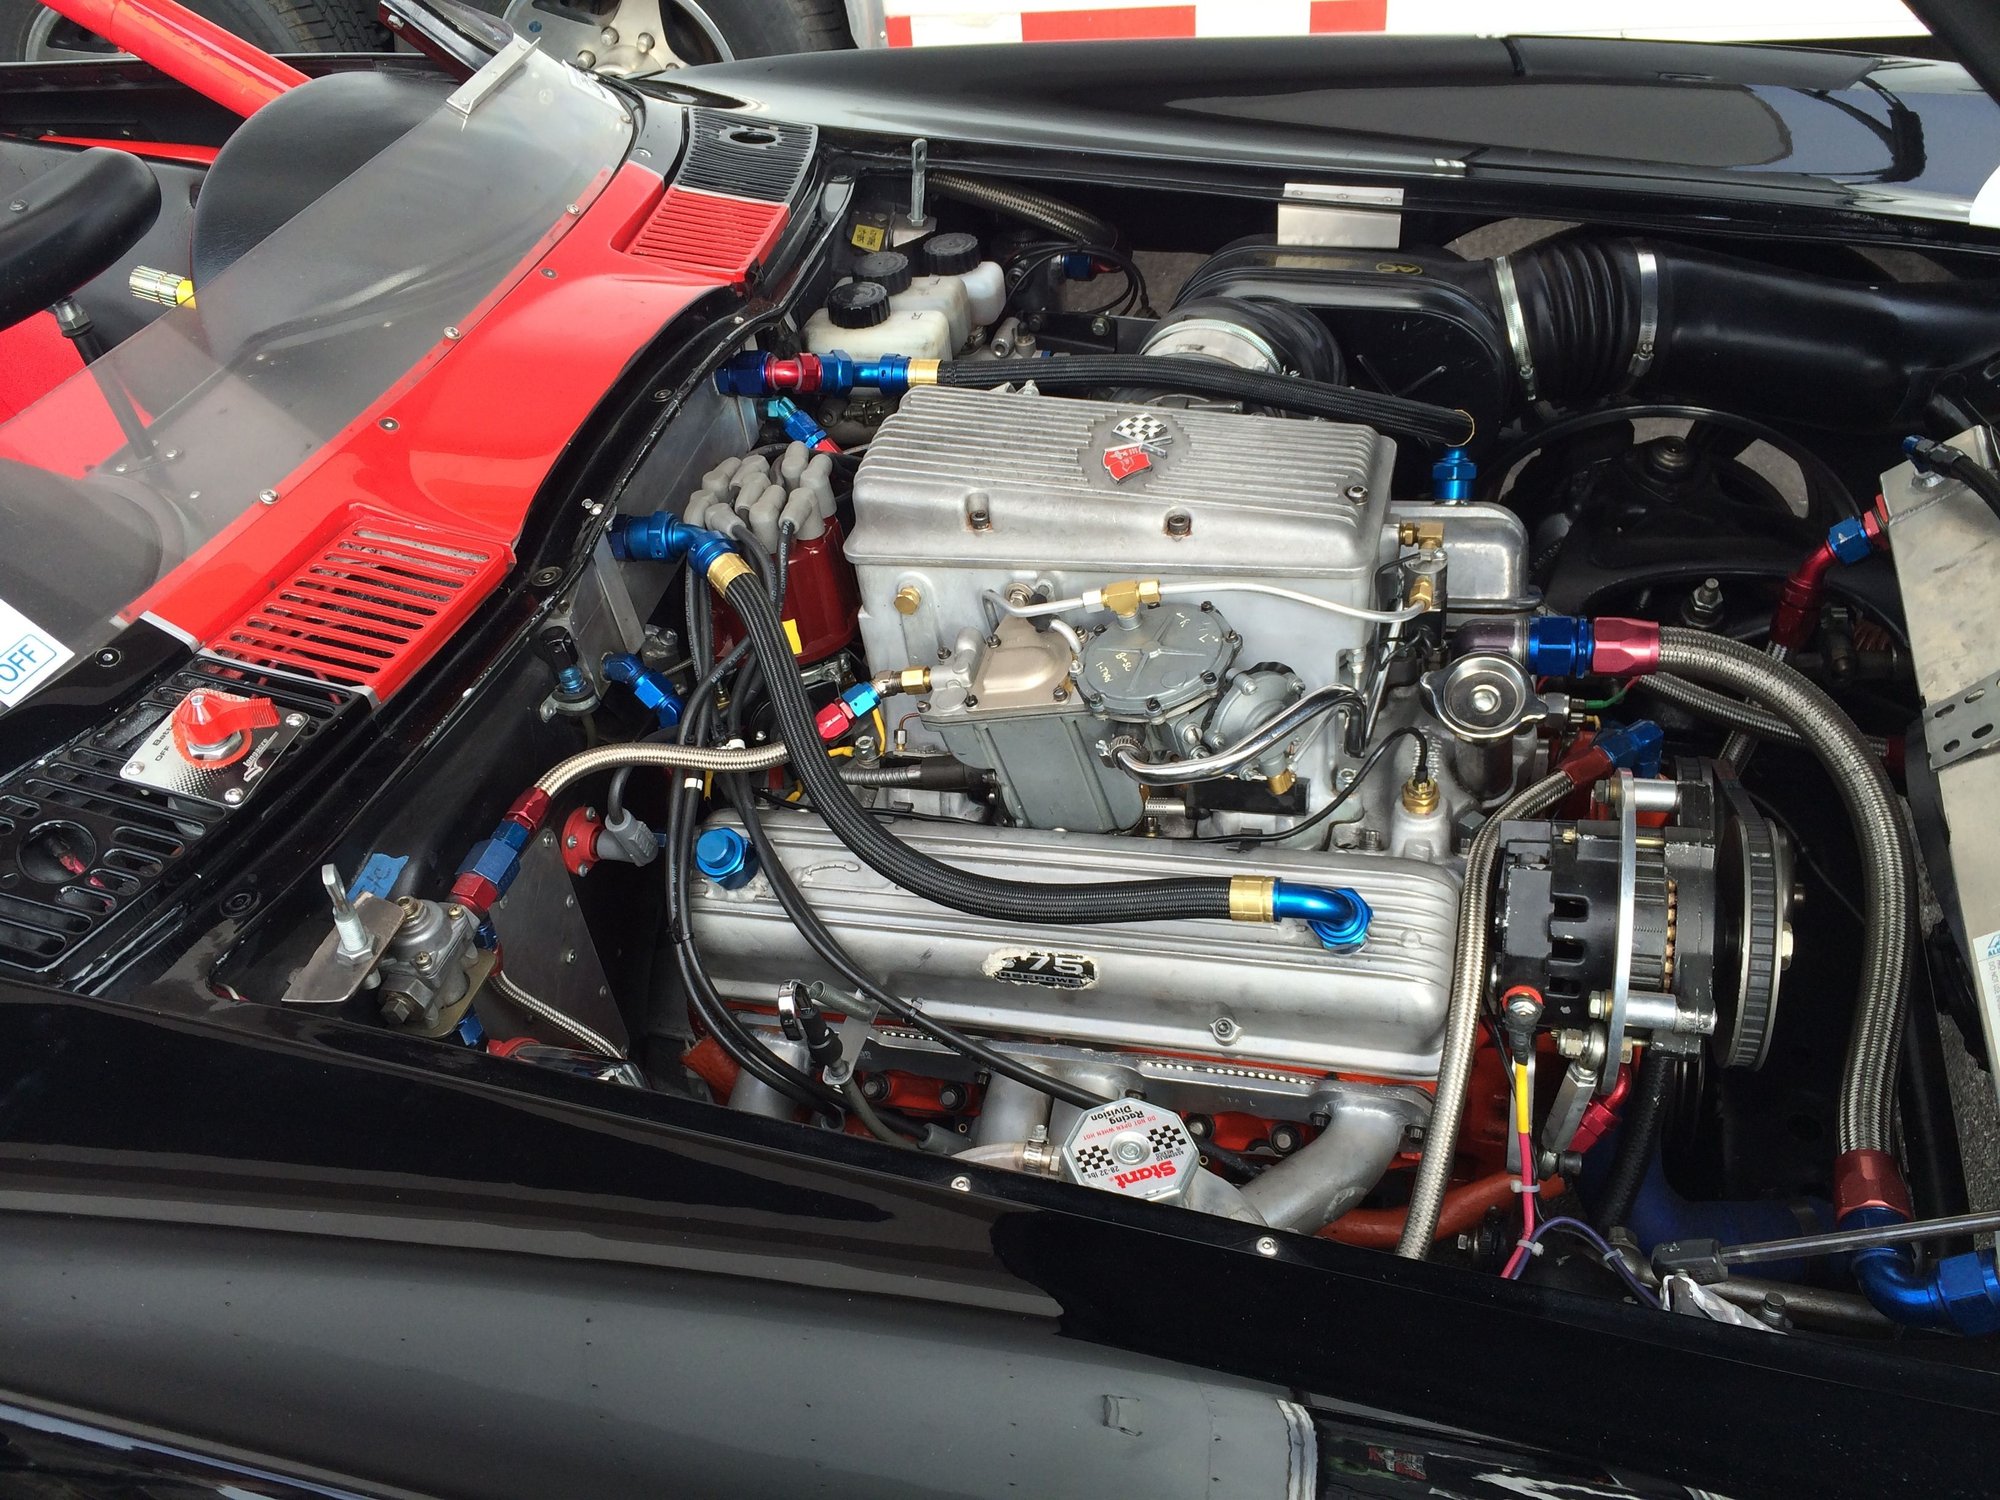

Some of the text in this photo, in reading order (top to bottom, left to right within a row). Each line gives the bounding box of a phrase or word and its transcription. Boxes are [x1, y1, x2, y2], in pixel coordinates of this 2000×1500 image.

[0, 643, 38, 682] OFF
[155, 744, 170, 762] OFF
[1090, 1105, 1133, 1121] Division
[1109, 1110, 1145, 1126] Racing
[1115, 1121, 1133, 1131] OPEN
[1133, 1117, 1146, 1126] NOT
[1083, 1132, 1096, 1140] HOT
[1096, 1126, 1115, 1136] WHEN
[1099, 1165, 1120, 1177] 28-32
[1114, 1160, 1177, 1189] Stant
